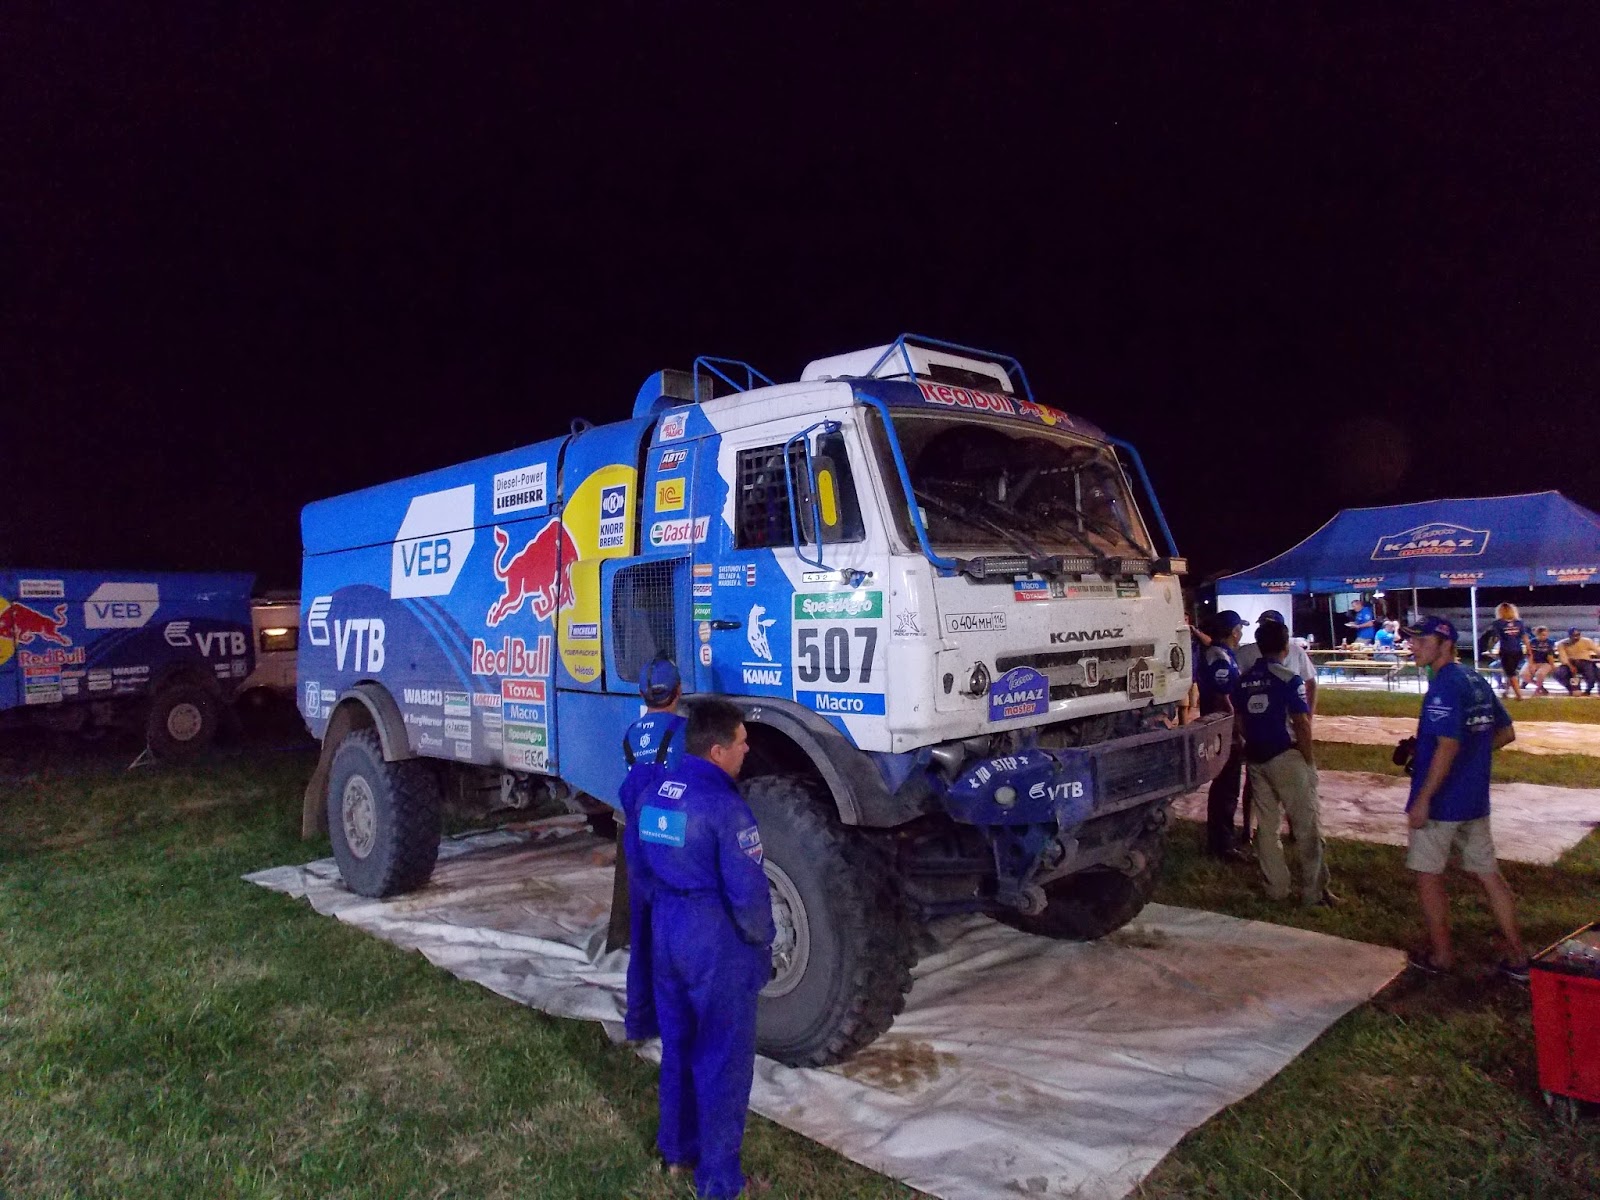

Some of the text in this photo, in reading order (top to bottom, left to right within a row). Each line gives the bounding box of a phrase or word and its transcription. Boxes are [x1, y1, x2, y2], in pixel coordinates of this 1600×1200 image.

[496, 471, 544, 491] Diesel-Power
[496, 488, 544, 509] LIEBHERR
[600, 522, 624, 536] KNORR
[663, 521, 705, 542] Castrol
[599, 535, 624, 547] BREMSE
[1383, 540, 1474, 551] KAMAZ
[402, 538, 451, 577] VEB
[1547, 567, 1597, 576] KAMAZ
[1021, 581, 1039, 590] Macro
[93, 603, 142, 619] VEB
[801, 598, 873, 616] SpeedAgro
[572, 626, 597, 636] MICHELIN
[1050, 628, 1124, 644] KAMAZ
[195, 631, 247, 657] VTB
[334, 618, 386, 673] VTB
[19, 647, 86, 667] Red Bull
[472, 635, 551, 677] Red Bull
[797, 626, 878, 684] 507
[741, 669, 783, 686] KAMAZ
[1140, 672, 1154, 690] 507
[403, 688, 443, 706] WABCO
[506, 683, 541, 698] TOTAL
[993, 688, 1044, 706] KAMAZ
[815, 694, 864, 712] Macro
[1004, 703, 1037, 717] master
[510, 706, 539, 720] Macro
[975, 755, 1018, 784] NO STEP
[1047, 781, 1084, 801] VTB
